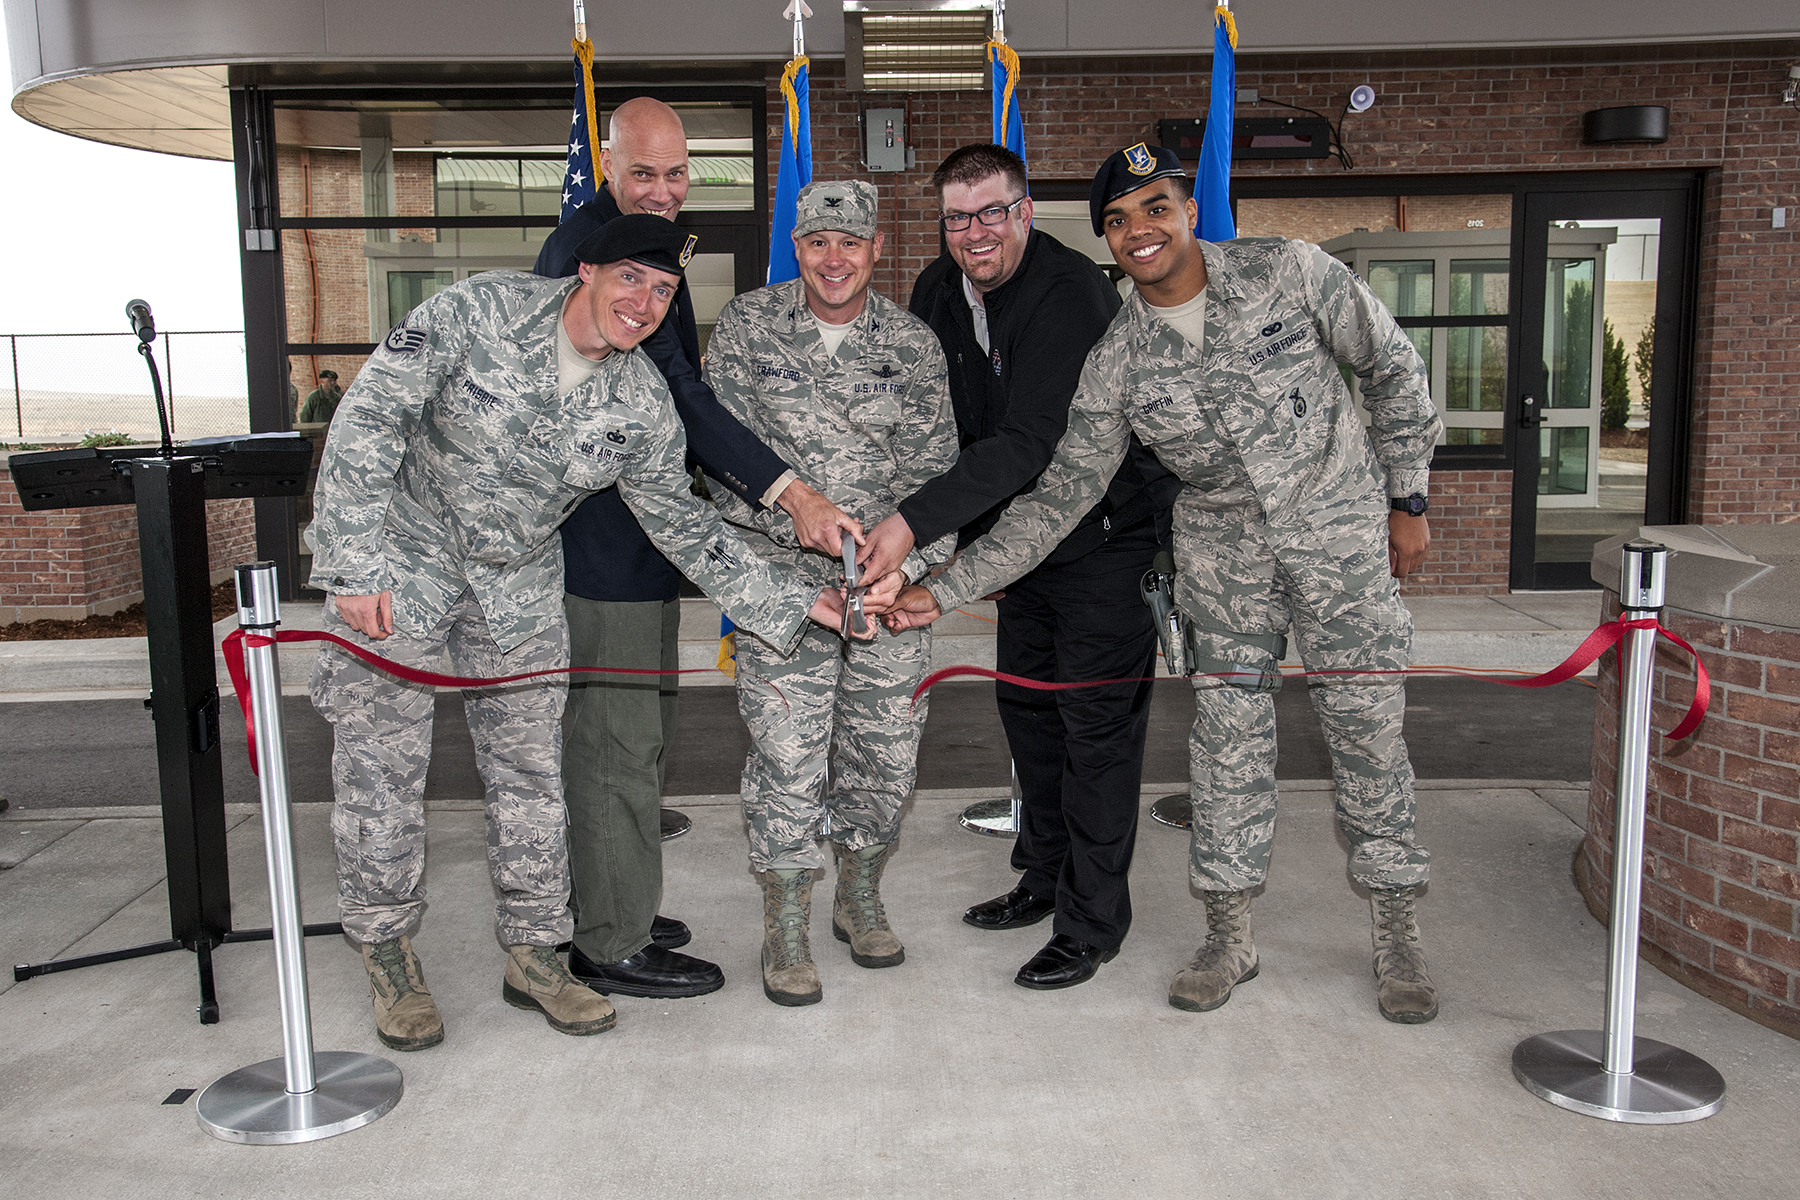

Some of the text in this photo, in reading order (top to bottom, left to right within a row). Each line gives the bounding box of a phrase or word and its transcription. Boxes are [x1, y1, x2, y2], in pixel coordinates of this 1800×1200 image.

[1249, 327, 1308, 366] U.S. AIR FORCE
[757, 365, 800, 382] CRAWFORD
[462, 379, 500, 408] FRISBIE
[854, 383, 872, 393] U.S.
[873, 383, 888, 393] AIR
[1142, 394, 1174, 415] GRIFFIN
[581, 441, 596, 456] U.S.
[597, 447, 613, 461] AIR
